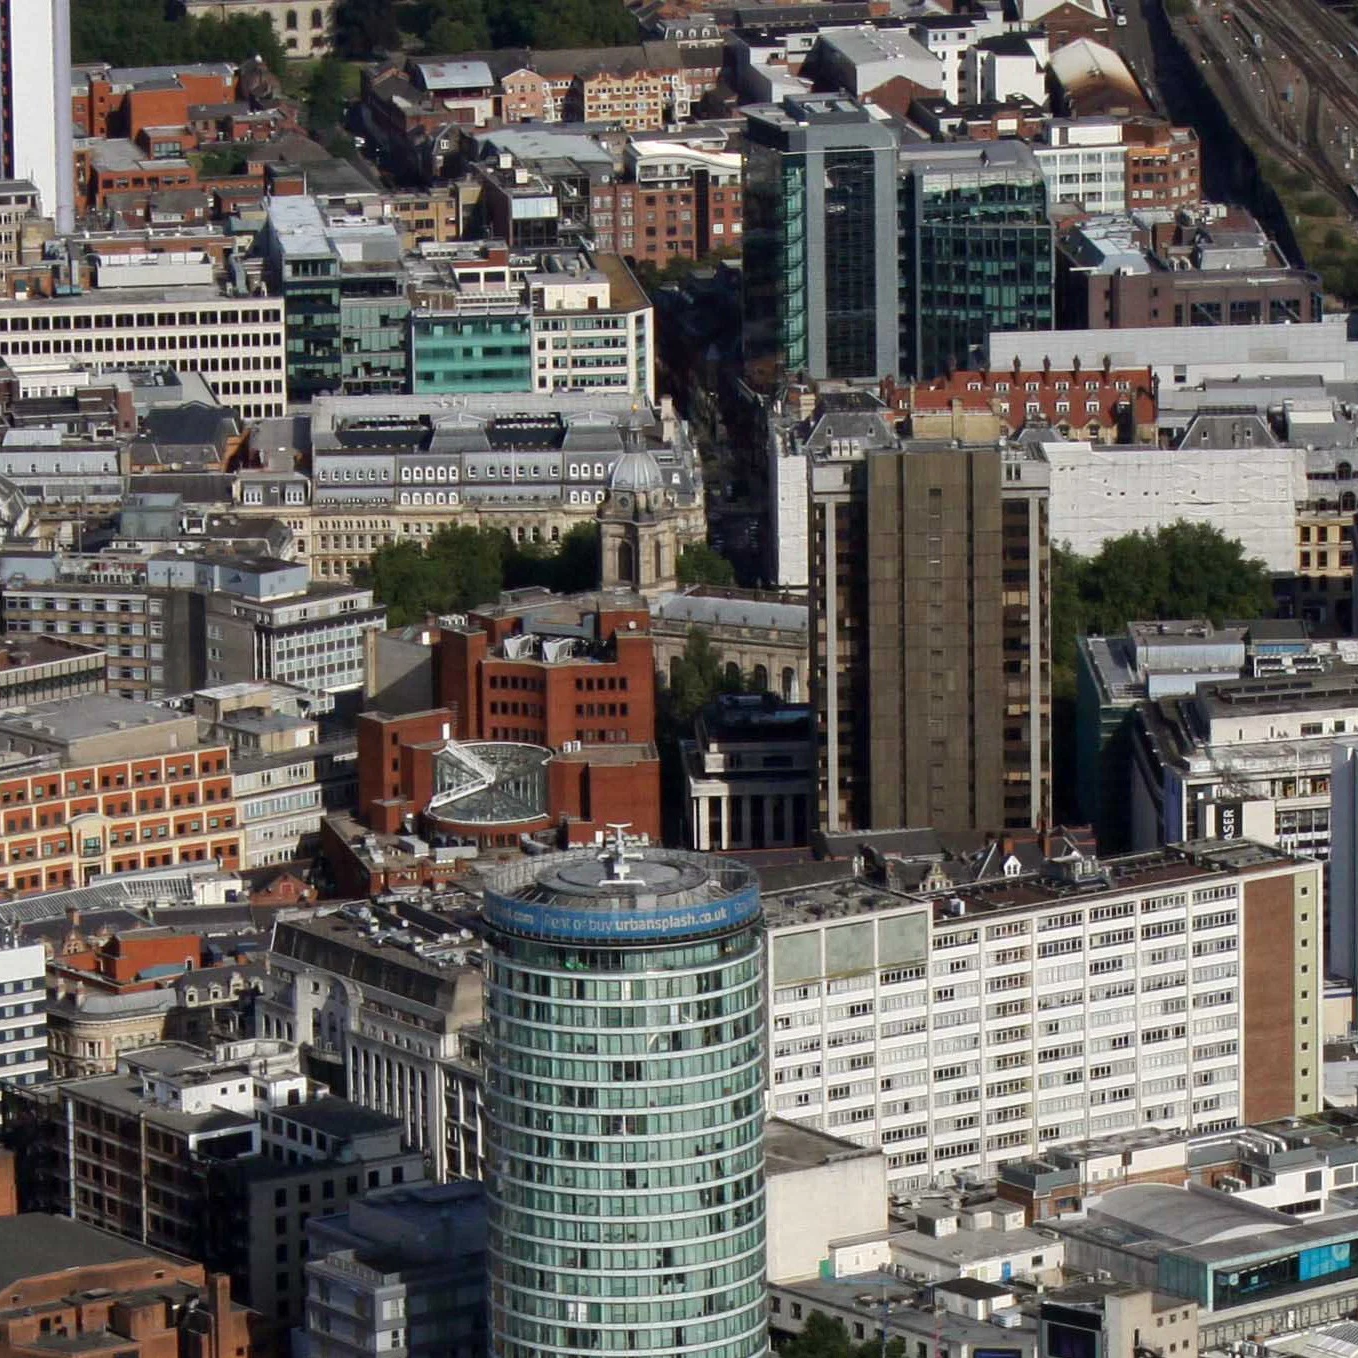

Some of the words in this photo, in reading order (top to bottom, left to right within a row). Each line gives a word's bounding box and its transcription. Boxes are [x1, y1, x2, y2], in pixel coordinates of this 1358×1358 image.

[1222, 809, 1235, 840] ASER
[589, 917, 612, 932] buy
[615, 906, 728, 932] urbansplash.co.uk
